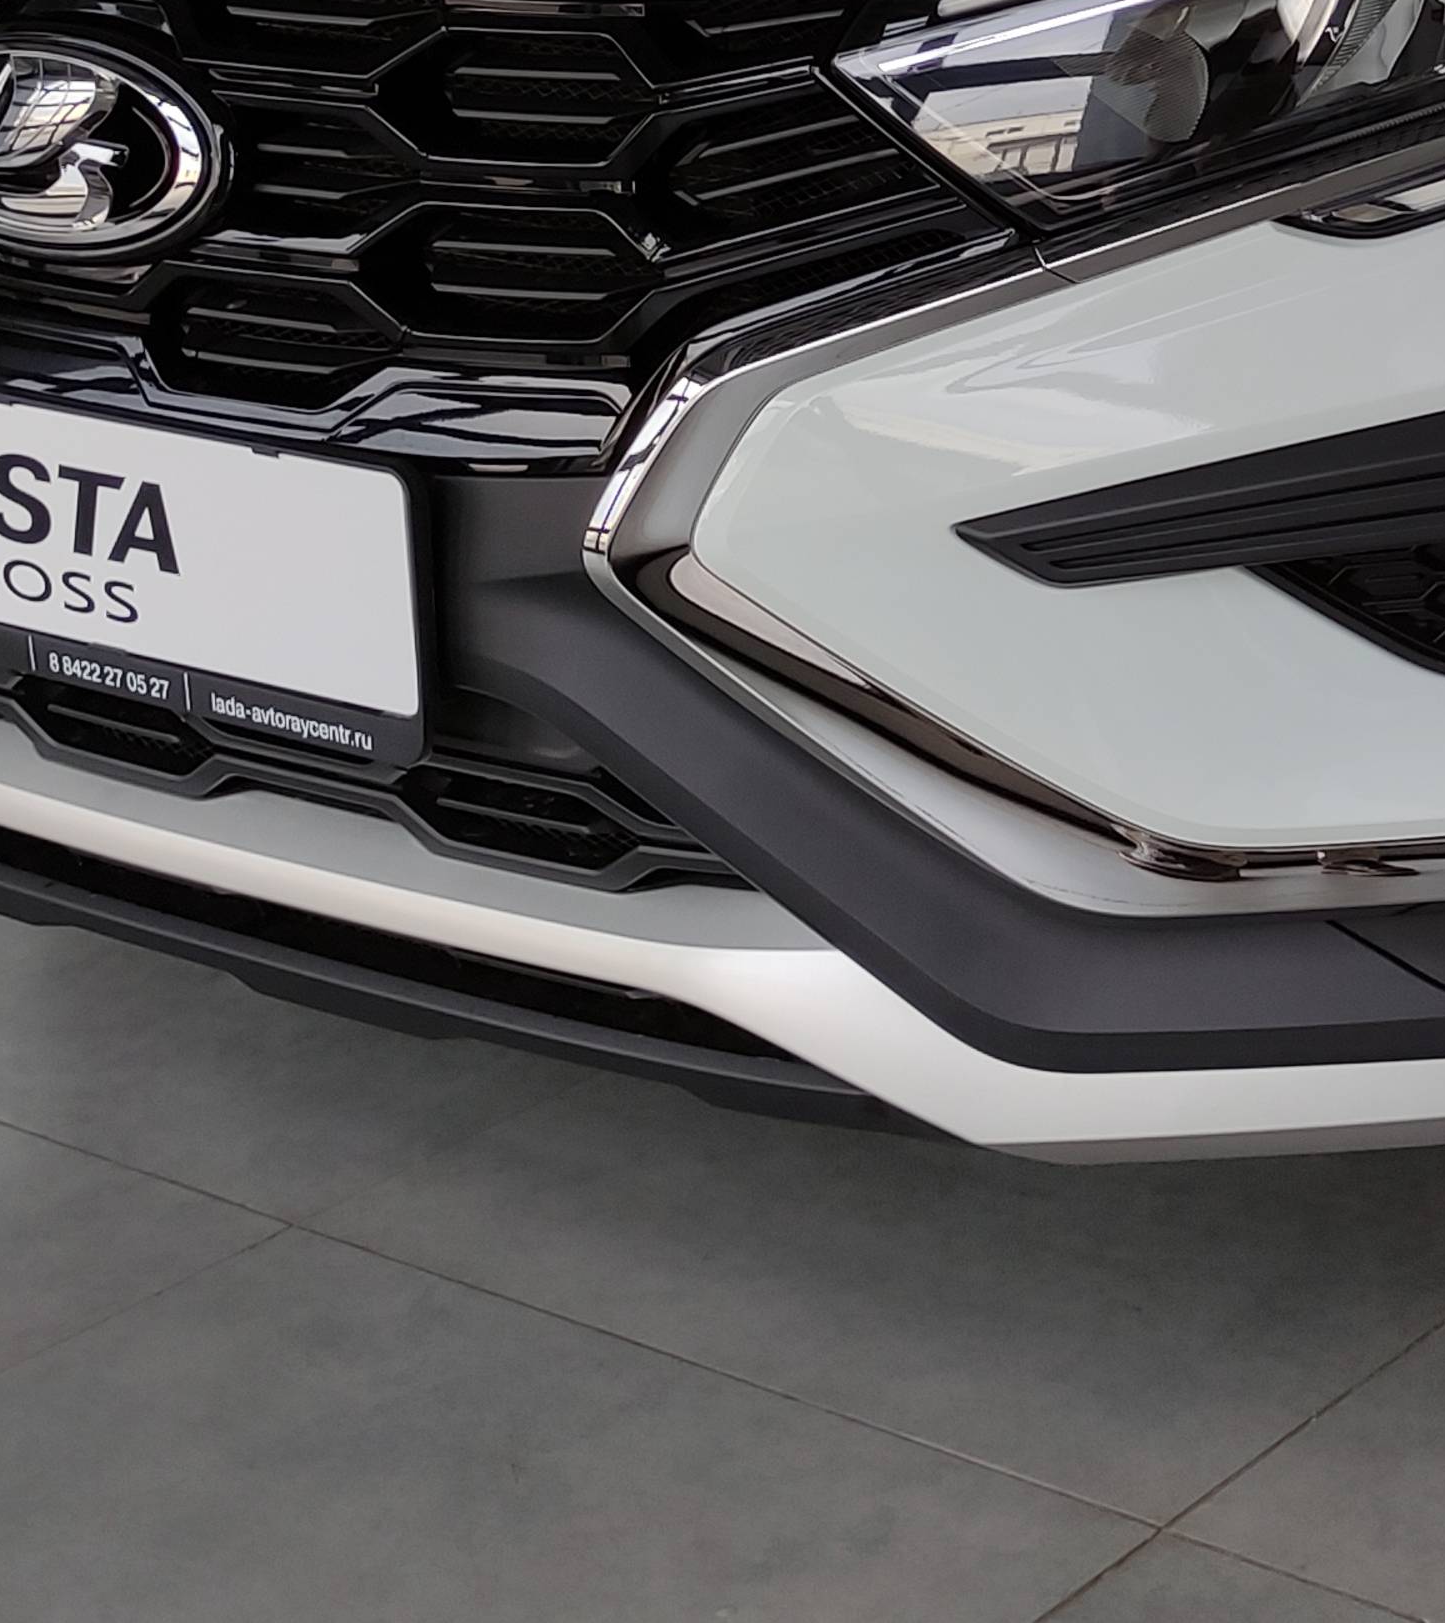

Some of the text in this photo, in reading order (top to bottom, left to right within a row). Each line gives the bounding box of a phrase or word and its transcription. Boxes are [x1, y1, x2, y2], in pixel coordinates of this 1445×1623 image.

[49, 652, 170, 700] 8 8422 27 05 27
[211, 692, 373, 751] lada-avtoraycentr.ru
